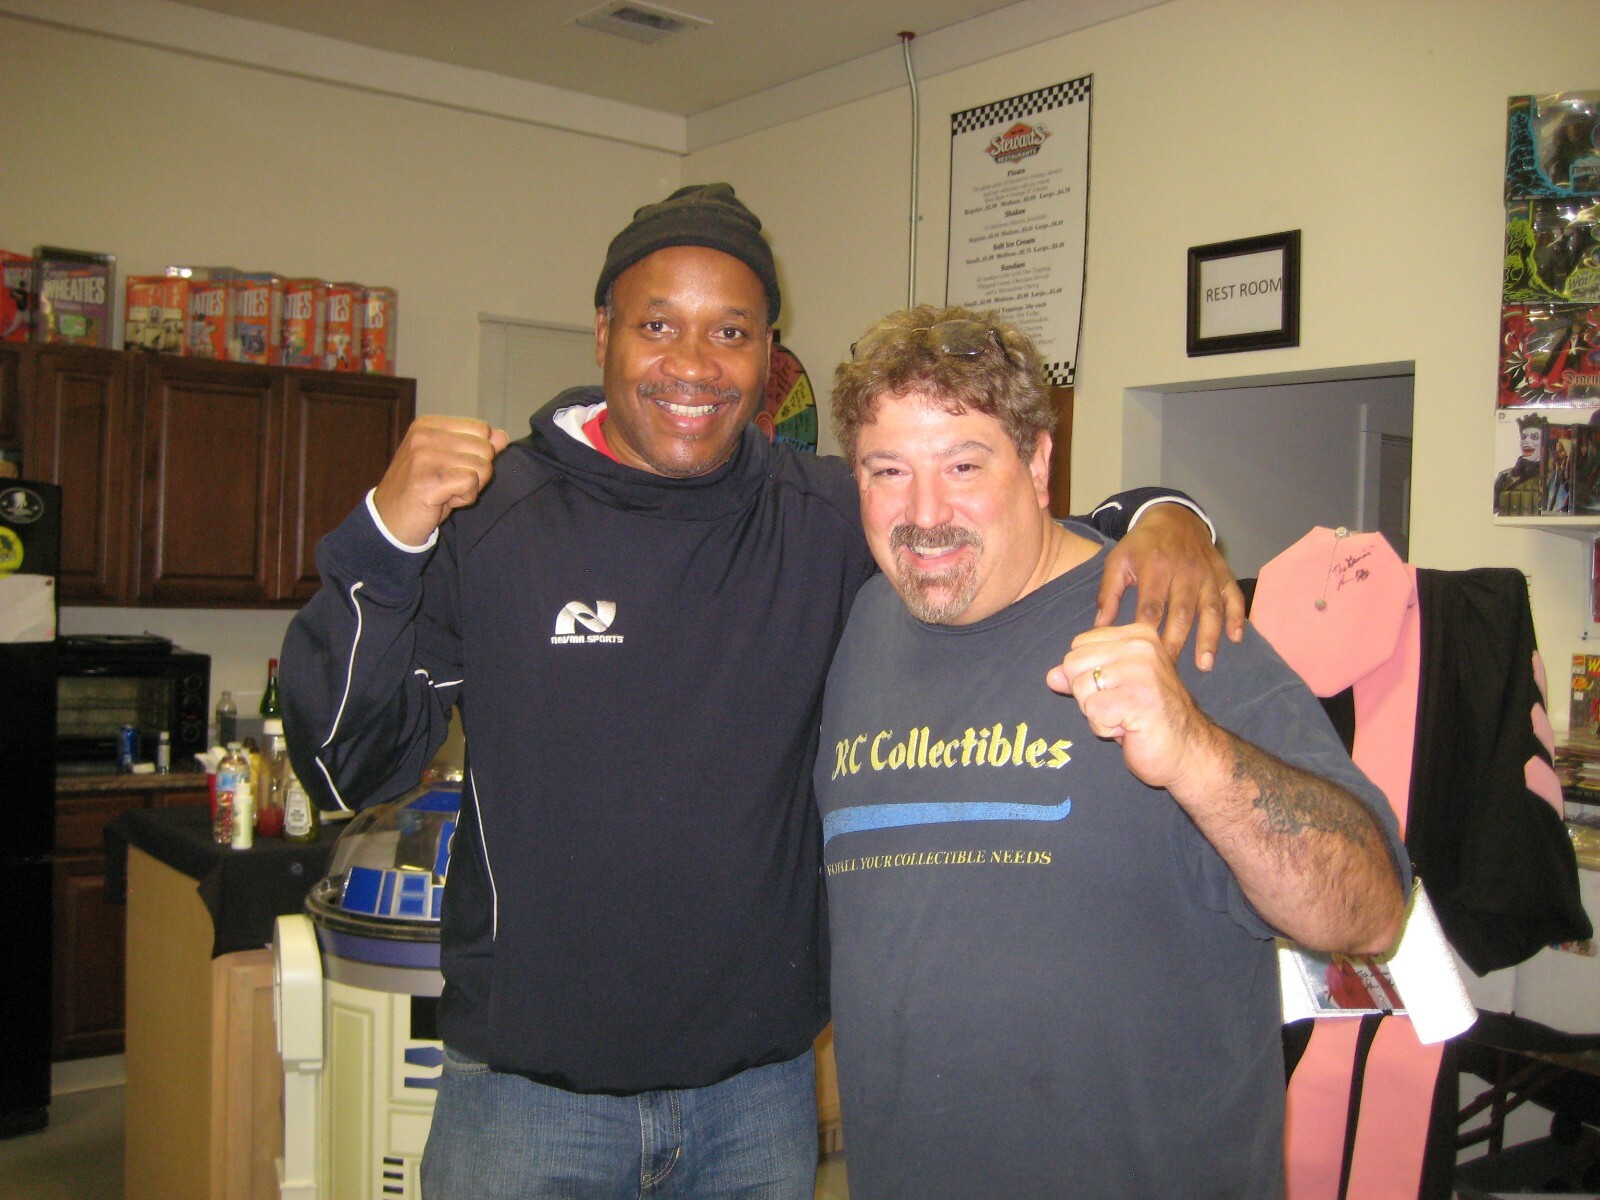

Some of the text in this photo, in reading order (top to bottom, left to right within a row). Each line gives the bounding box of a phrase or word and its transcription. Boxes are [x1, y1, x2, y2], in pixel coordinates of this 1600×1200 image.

[1004, 208, 1026, 218] Shakes
[1015, 238, 1036, 247] Cream
[1206, 277, 1282, 302] REST ROOM
[870, 722, 1073, 771] Collectibles
[860, 855, 892, 870] YOUR
[894, 850, 987, 866] COLLECTIBLE
[989, 850, 1052, 865] NEEDS
